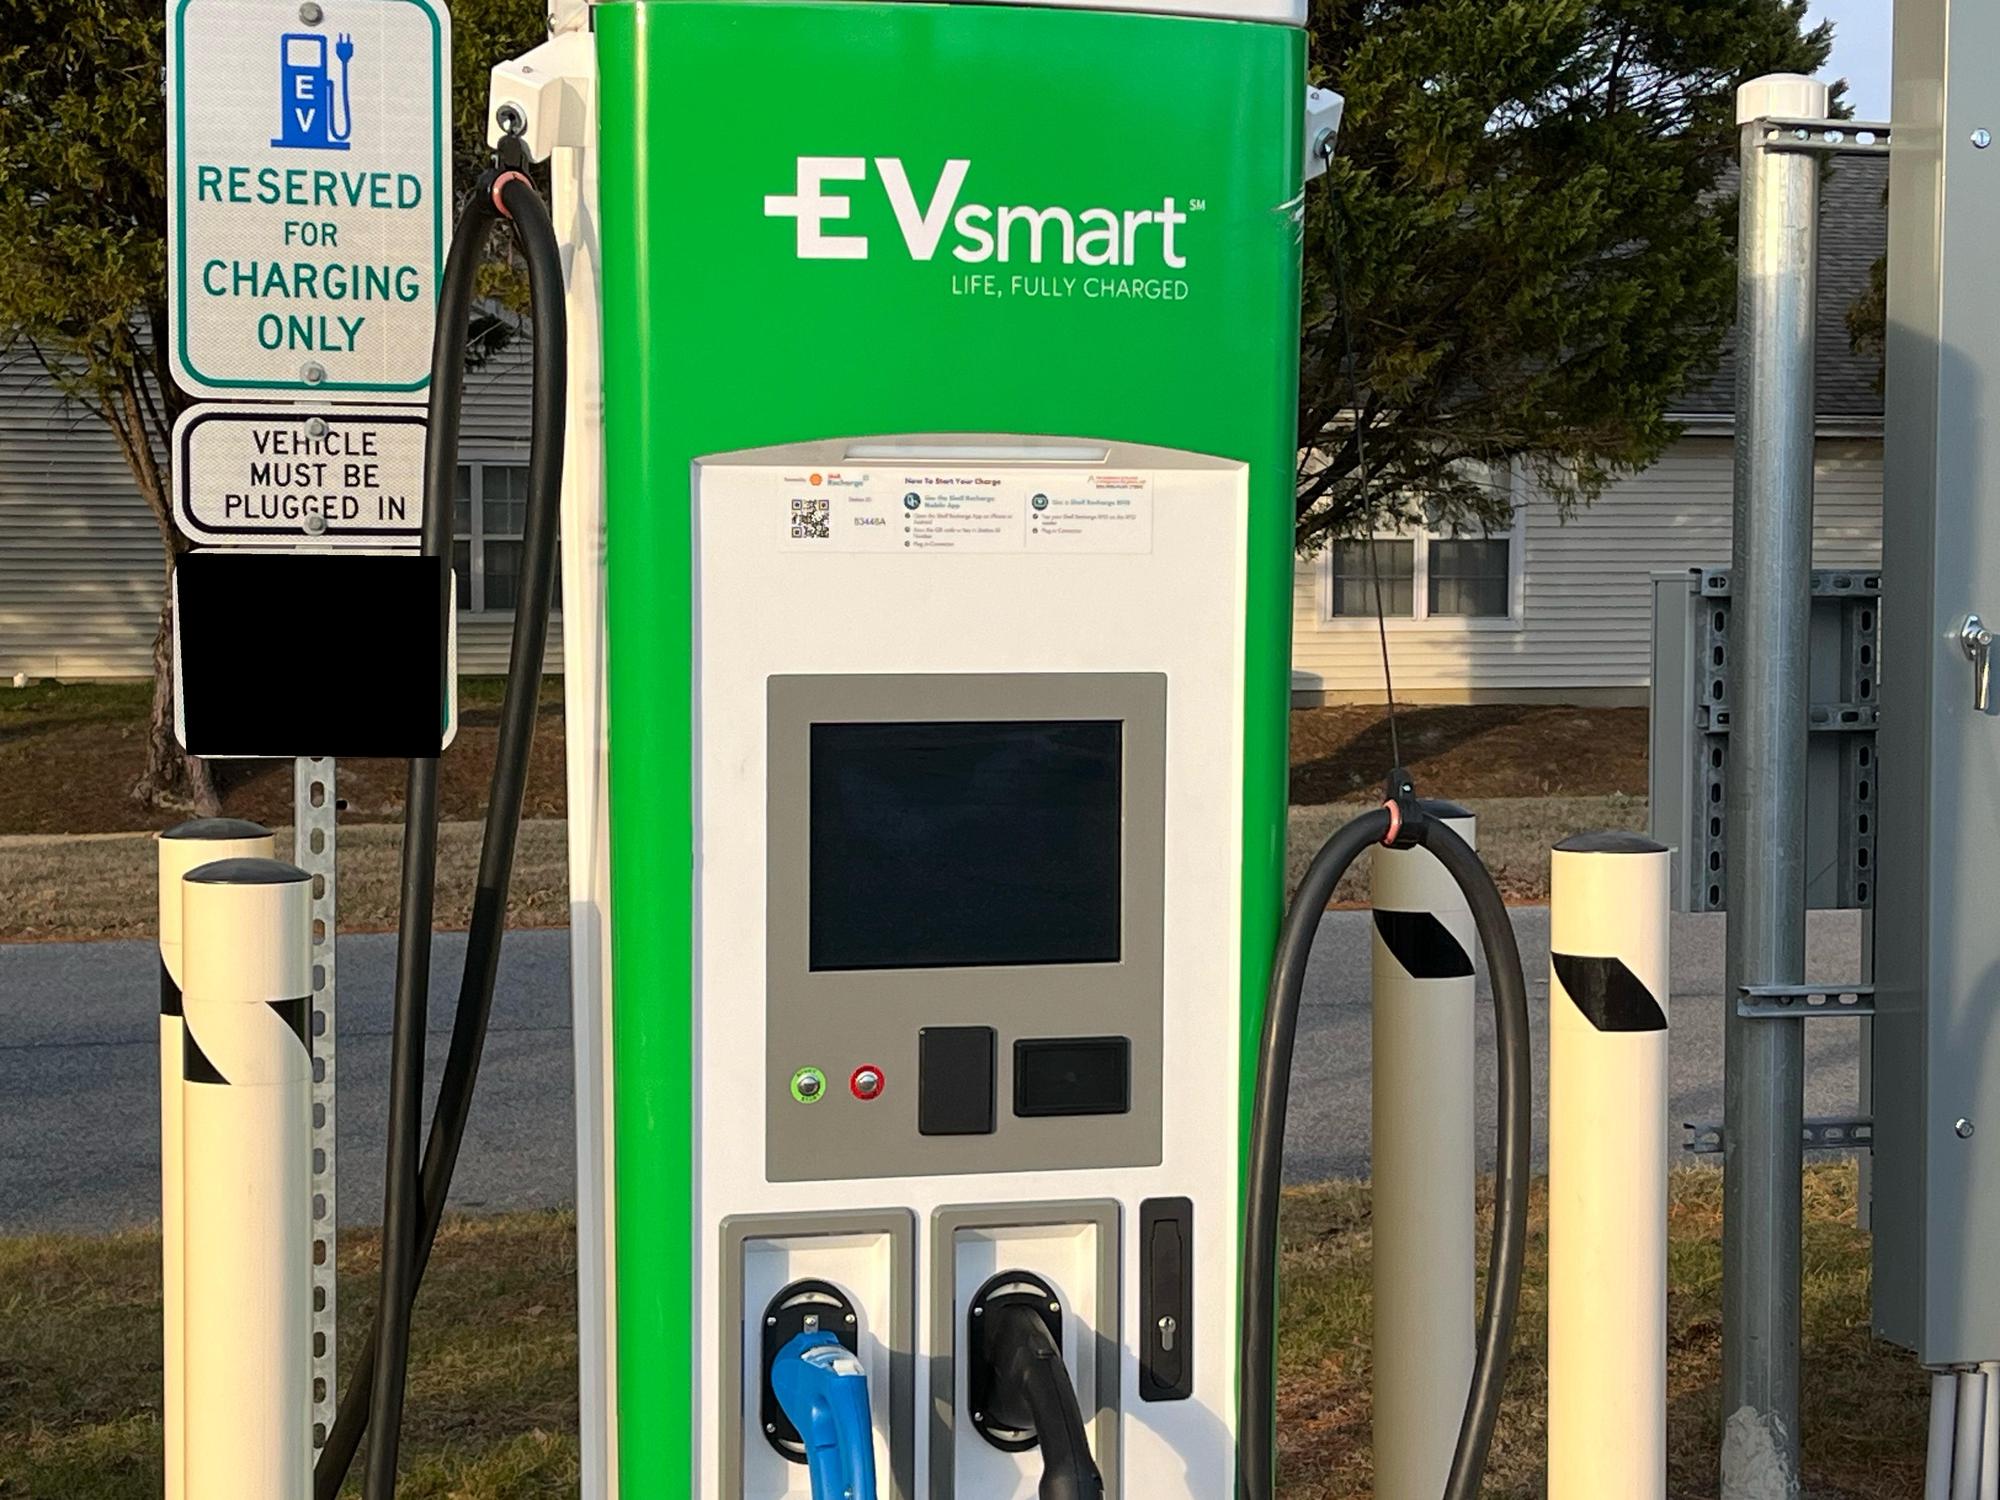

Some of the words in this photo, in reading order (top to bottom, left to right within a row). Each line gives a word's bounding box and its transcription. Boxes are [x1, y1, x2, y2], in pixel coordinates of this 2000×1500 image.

[198, 165, 422, 209] RESERVED
[284, 221, 338, 248] FOR
[203, 259, 420, 302] CHARGING
[951, 274, 1003, 299] LIFE,
[1011, 275, 1077, 297] FULLY
[1083, 277, 1189, 301] CHARGED
[257, 313, 366, 352] ONLY
[252, 430, 378, 457] VEHICLE
[250, 462, 327, 488] MUST
[344, 463, 380, 488] BE
[974, 477, 1001, 487] Charge
[224, 494, 359, 520] PLUGGED
[378, 496, 406, 521] IN
